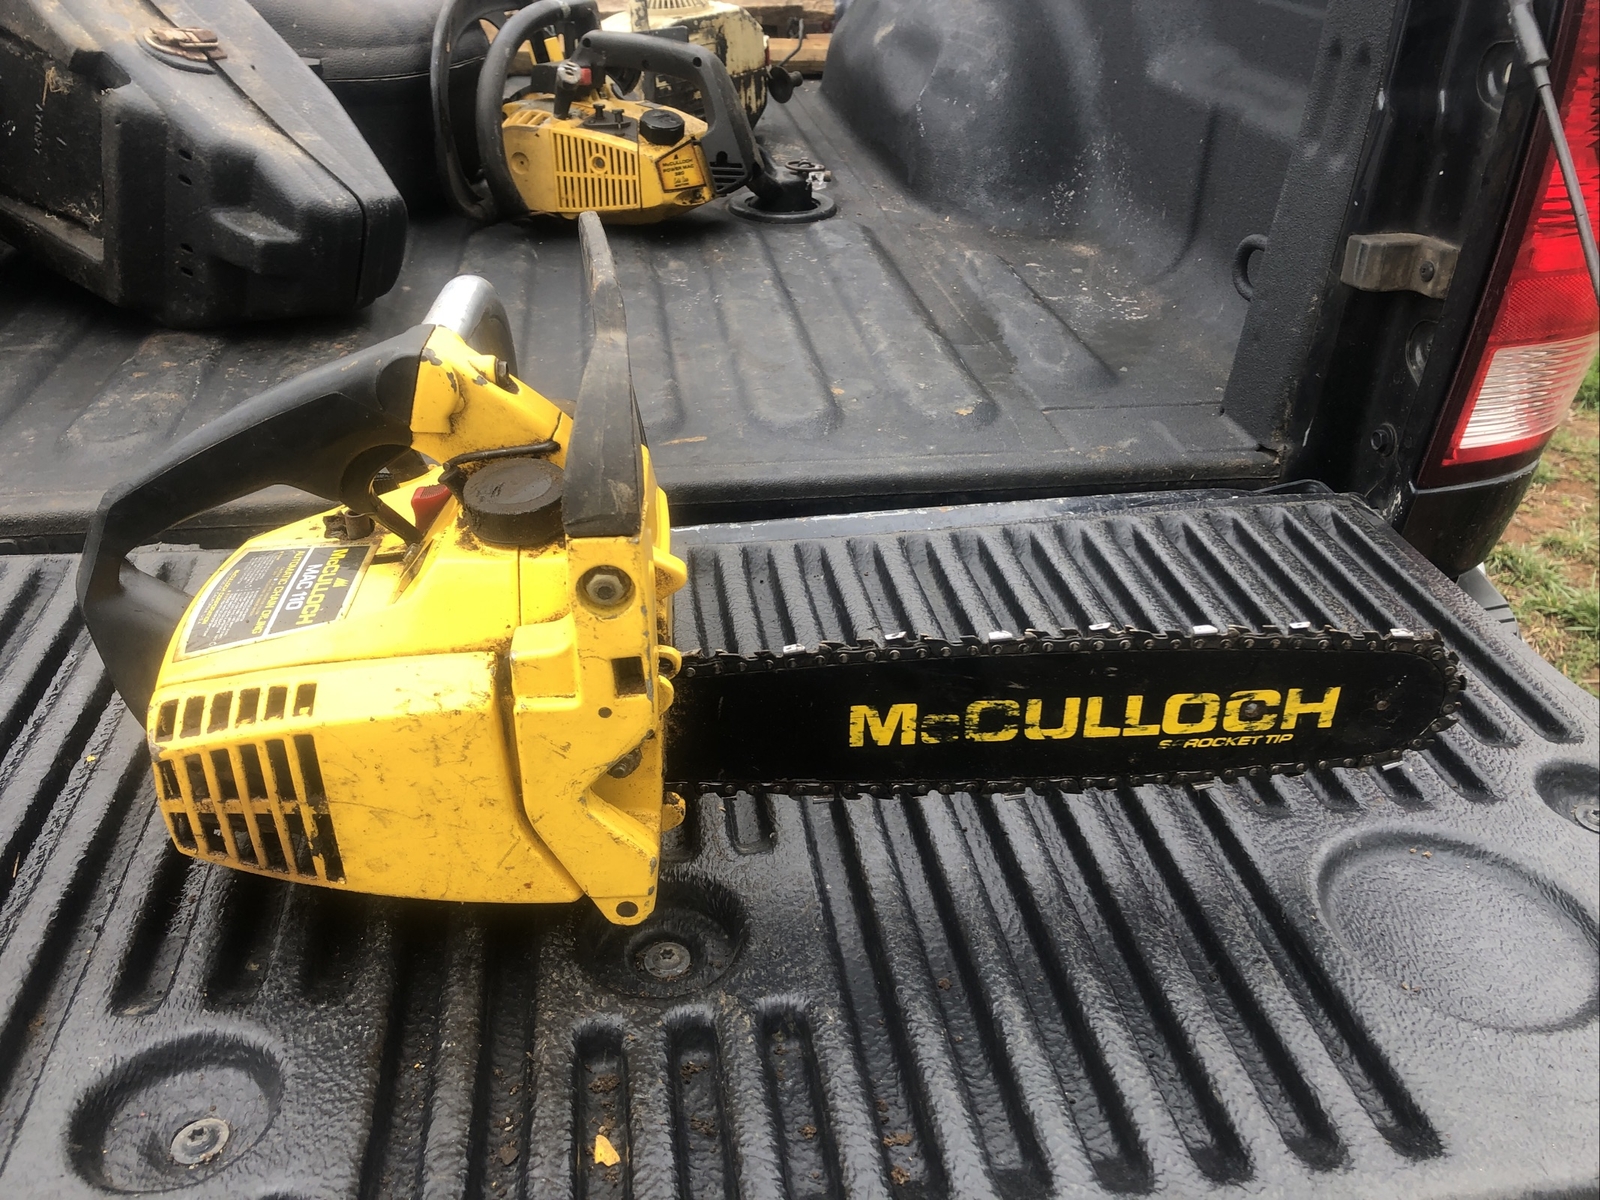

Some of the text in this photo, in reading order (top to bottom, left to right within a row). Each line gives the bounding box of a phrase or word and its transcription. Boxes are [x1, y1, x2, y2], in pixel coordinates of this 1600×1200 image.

[278, 551, 306, 585] AUTOMATIC
[285, 563, 323, 610] MAC 110
[296, 548, 349, 625] McCULLOCH
[265, 586, 285, 609] CHAIN
[849, 687, 1341, 747] McCULLOCH
[1265, 733, 1294, 744] TIP
